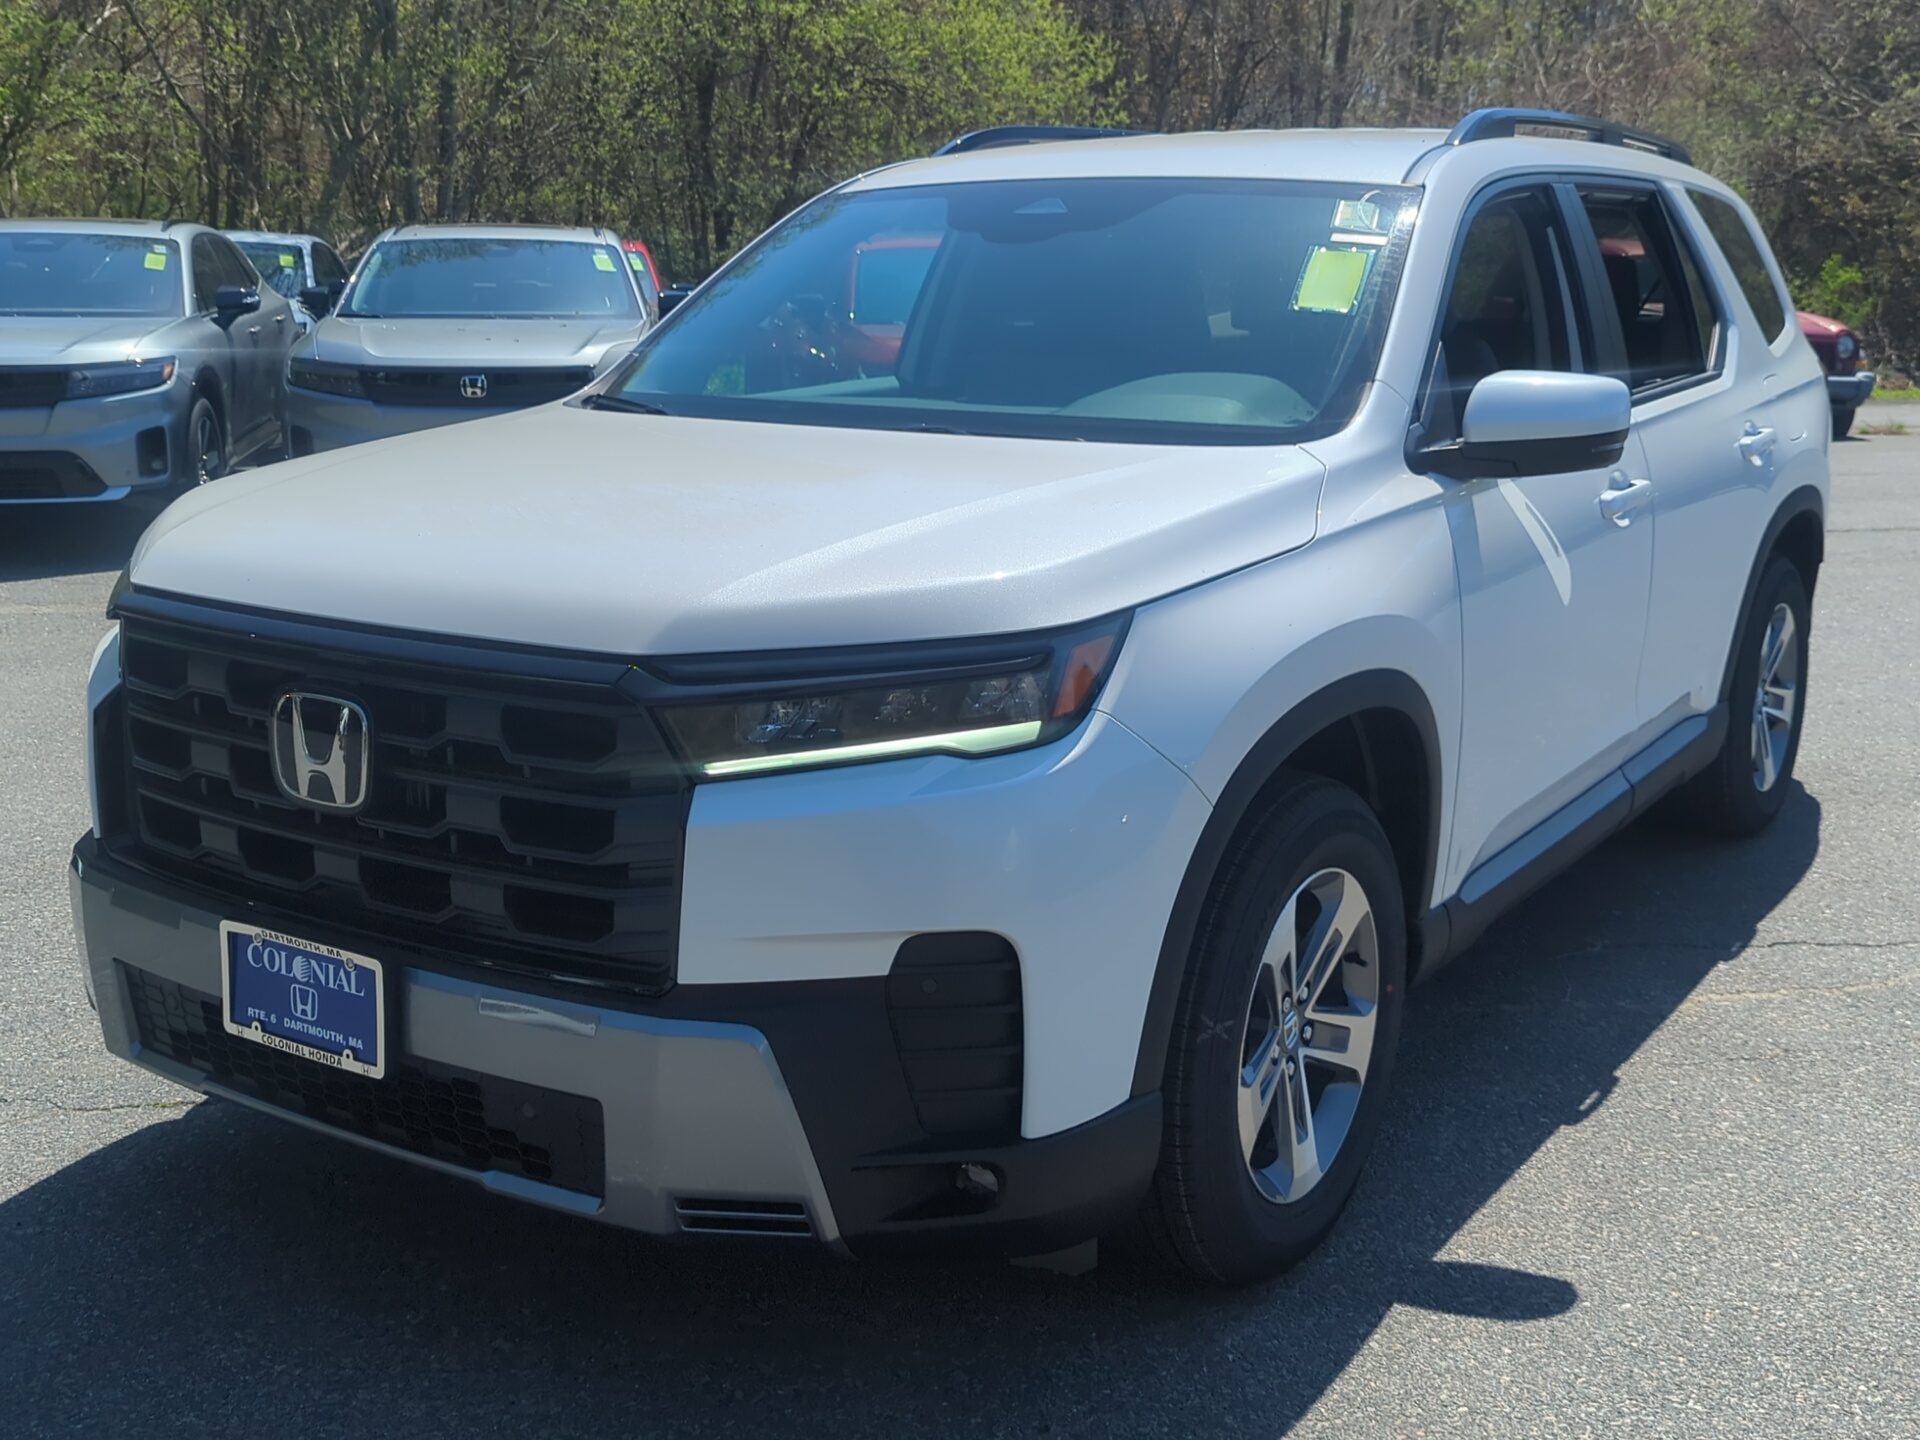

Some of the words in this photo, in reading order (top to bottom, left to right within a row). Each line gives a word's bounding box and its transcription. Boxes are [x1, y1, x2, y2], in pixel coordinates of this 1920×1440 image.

[247, 944, 365, 997] COLONIAL
[326, 948, 343, 959] MA
[247, 1007, 268, 1022] RTE.
[270, 1013, 277, 1024] 6
[283, 1017, 347, 1046] DARTMOUTH,
[348, 1036, 363, 1050] MA
[261, 1034, 306, 1056] COLONIAL
[308, 1050, 342, 1067] HONDA
